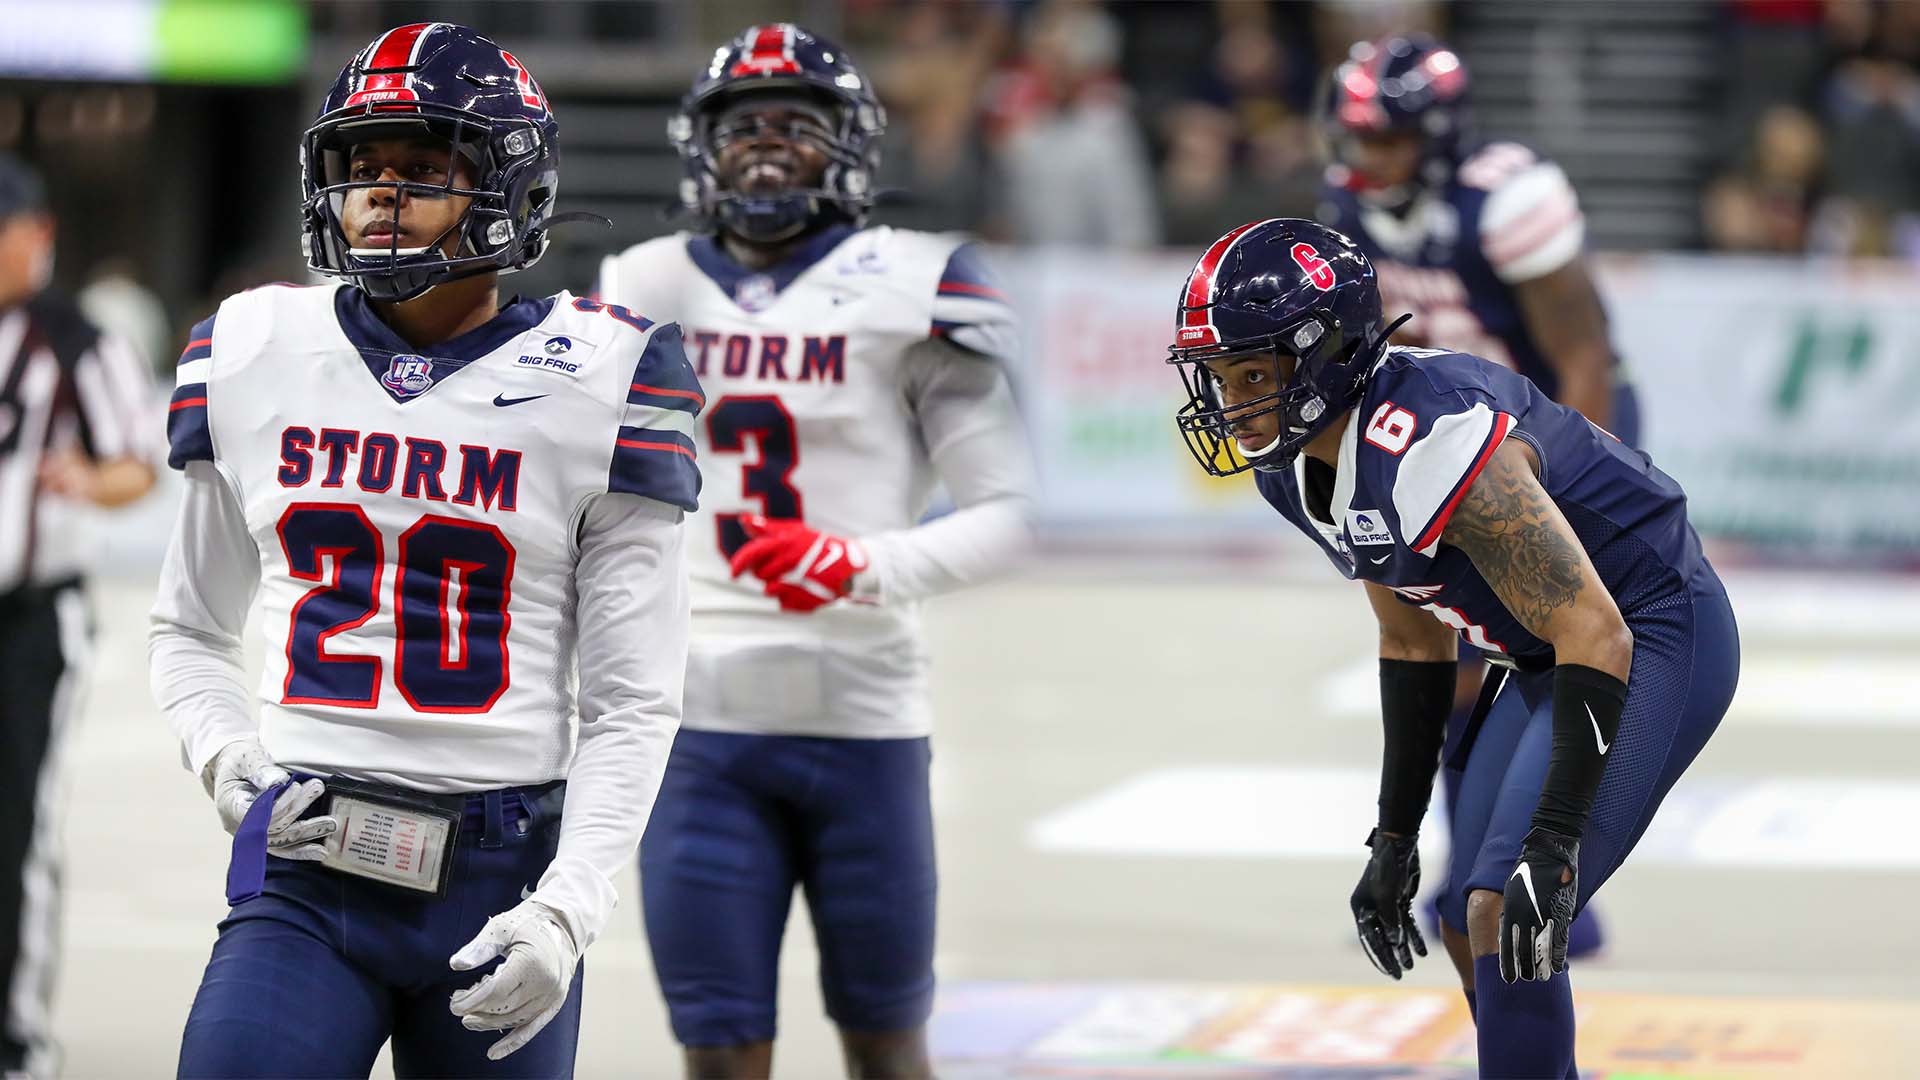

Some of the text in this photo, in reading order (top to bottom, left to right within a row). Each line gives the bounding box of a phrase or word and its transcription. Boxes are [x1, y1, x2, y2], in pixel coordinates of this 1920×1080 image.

[361, 91, 399, 102] STORM
[500, 49, 554, 115] 2
[393, 362, 425, 379] IFL
[518, 355, 578, 373] BIG FRIG
[685, 331, 847, 384] TORM
[1365, 400, 1417, 456] 6
[277, 426, 522, 513] STORM
[706, 395, 806, 566] 3
[1353, 534, 1390, 543] BIG FRIG
[276, 502, 517, 715] 20
